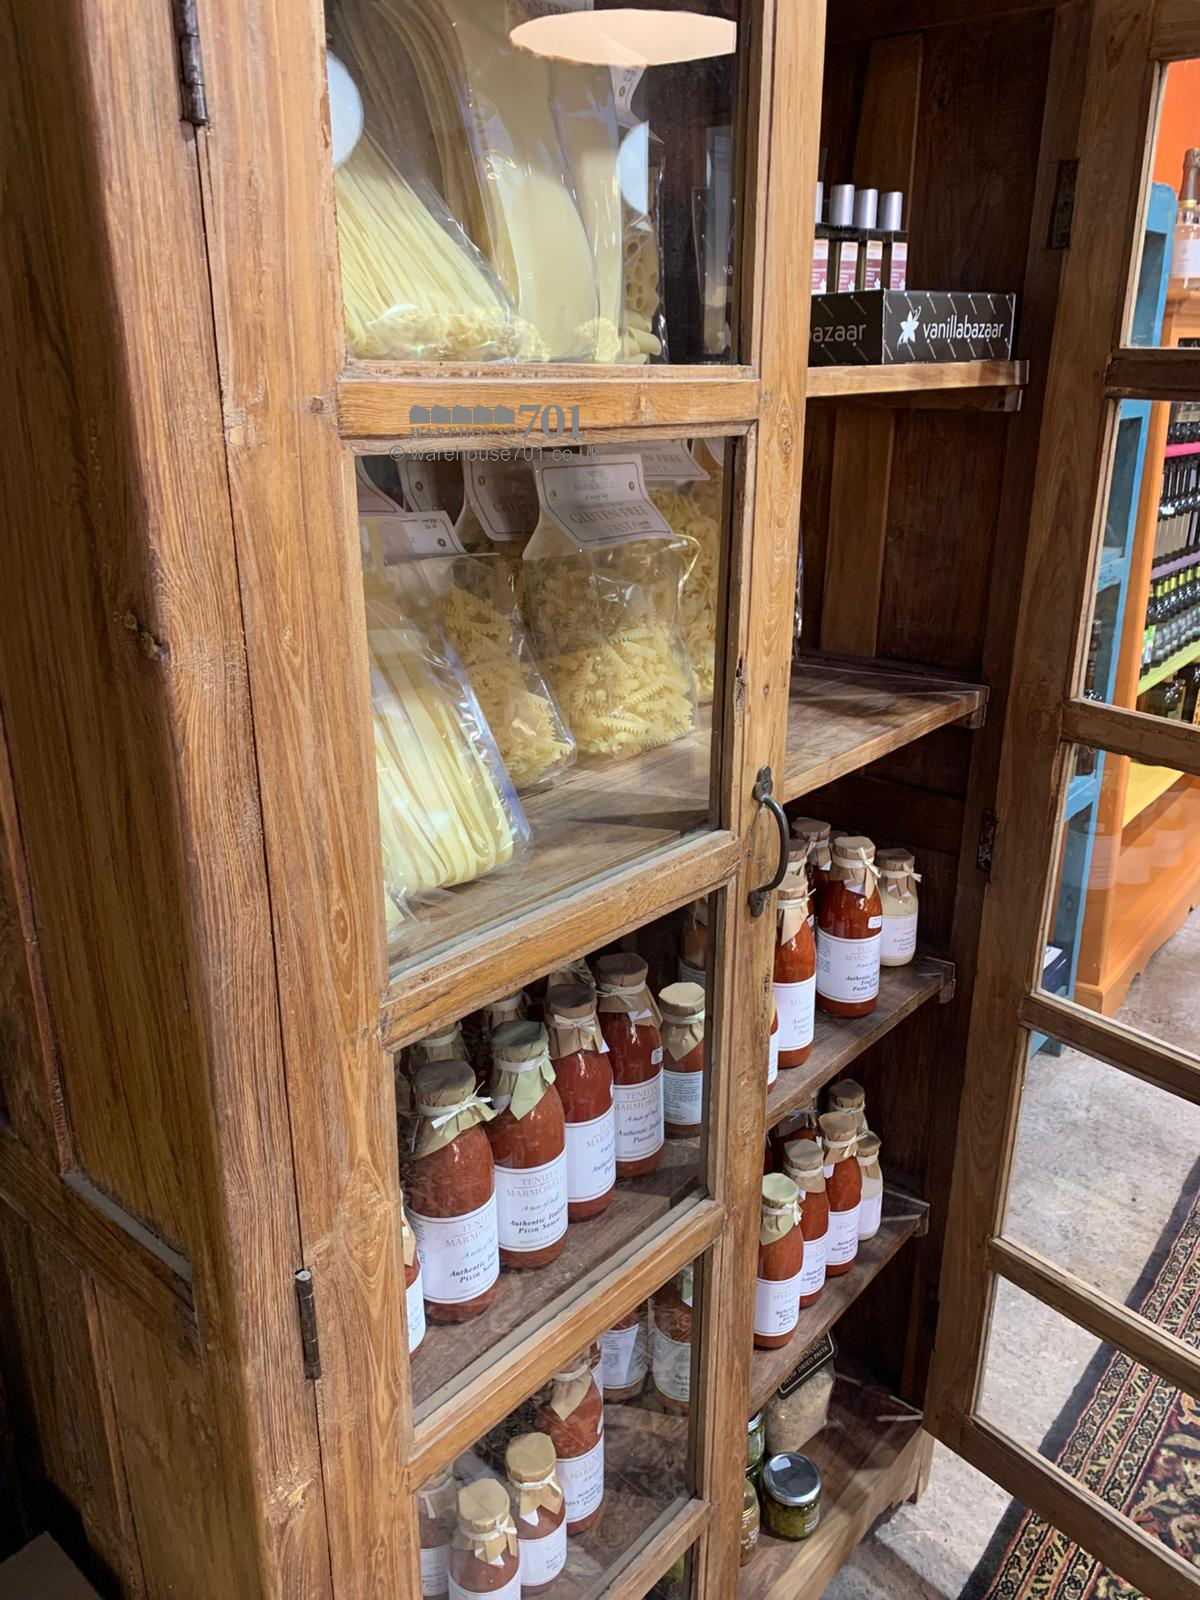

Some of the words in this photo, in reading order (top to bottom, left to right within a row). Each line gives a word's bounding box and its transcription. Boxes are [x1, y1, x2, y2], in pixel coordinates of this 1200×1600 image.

[923, 313, 1004, 339] vanillabazaar
[569, 508, 620, 524] GLUTEN
[620, 505, 649, 518] FREE
[510, 1217, 546, 1227] Authentic
[518, 1226, 540, 1234] Pizza
